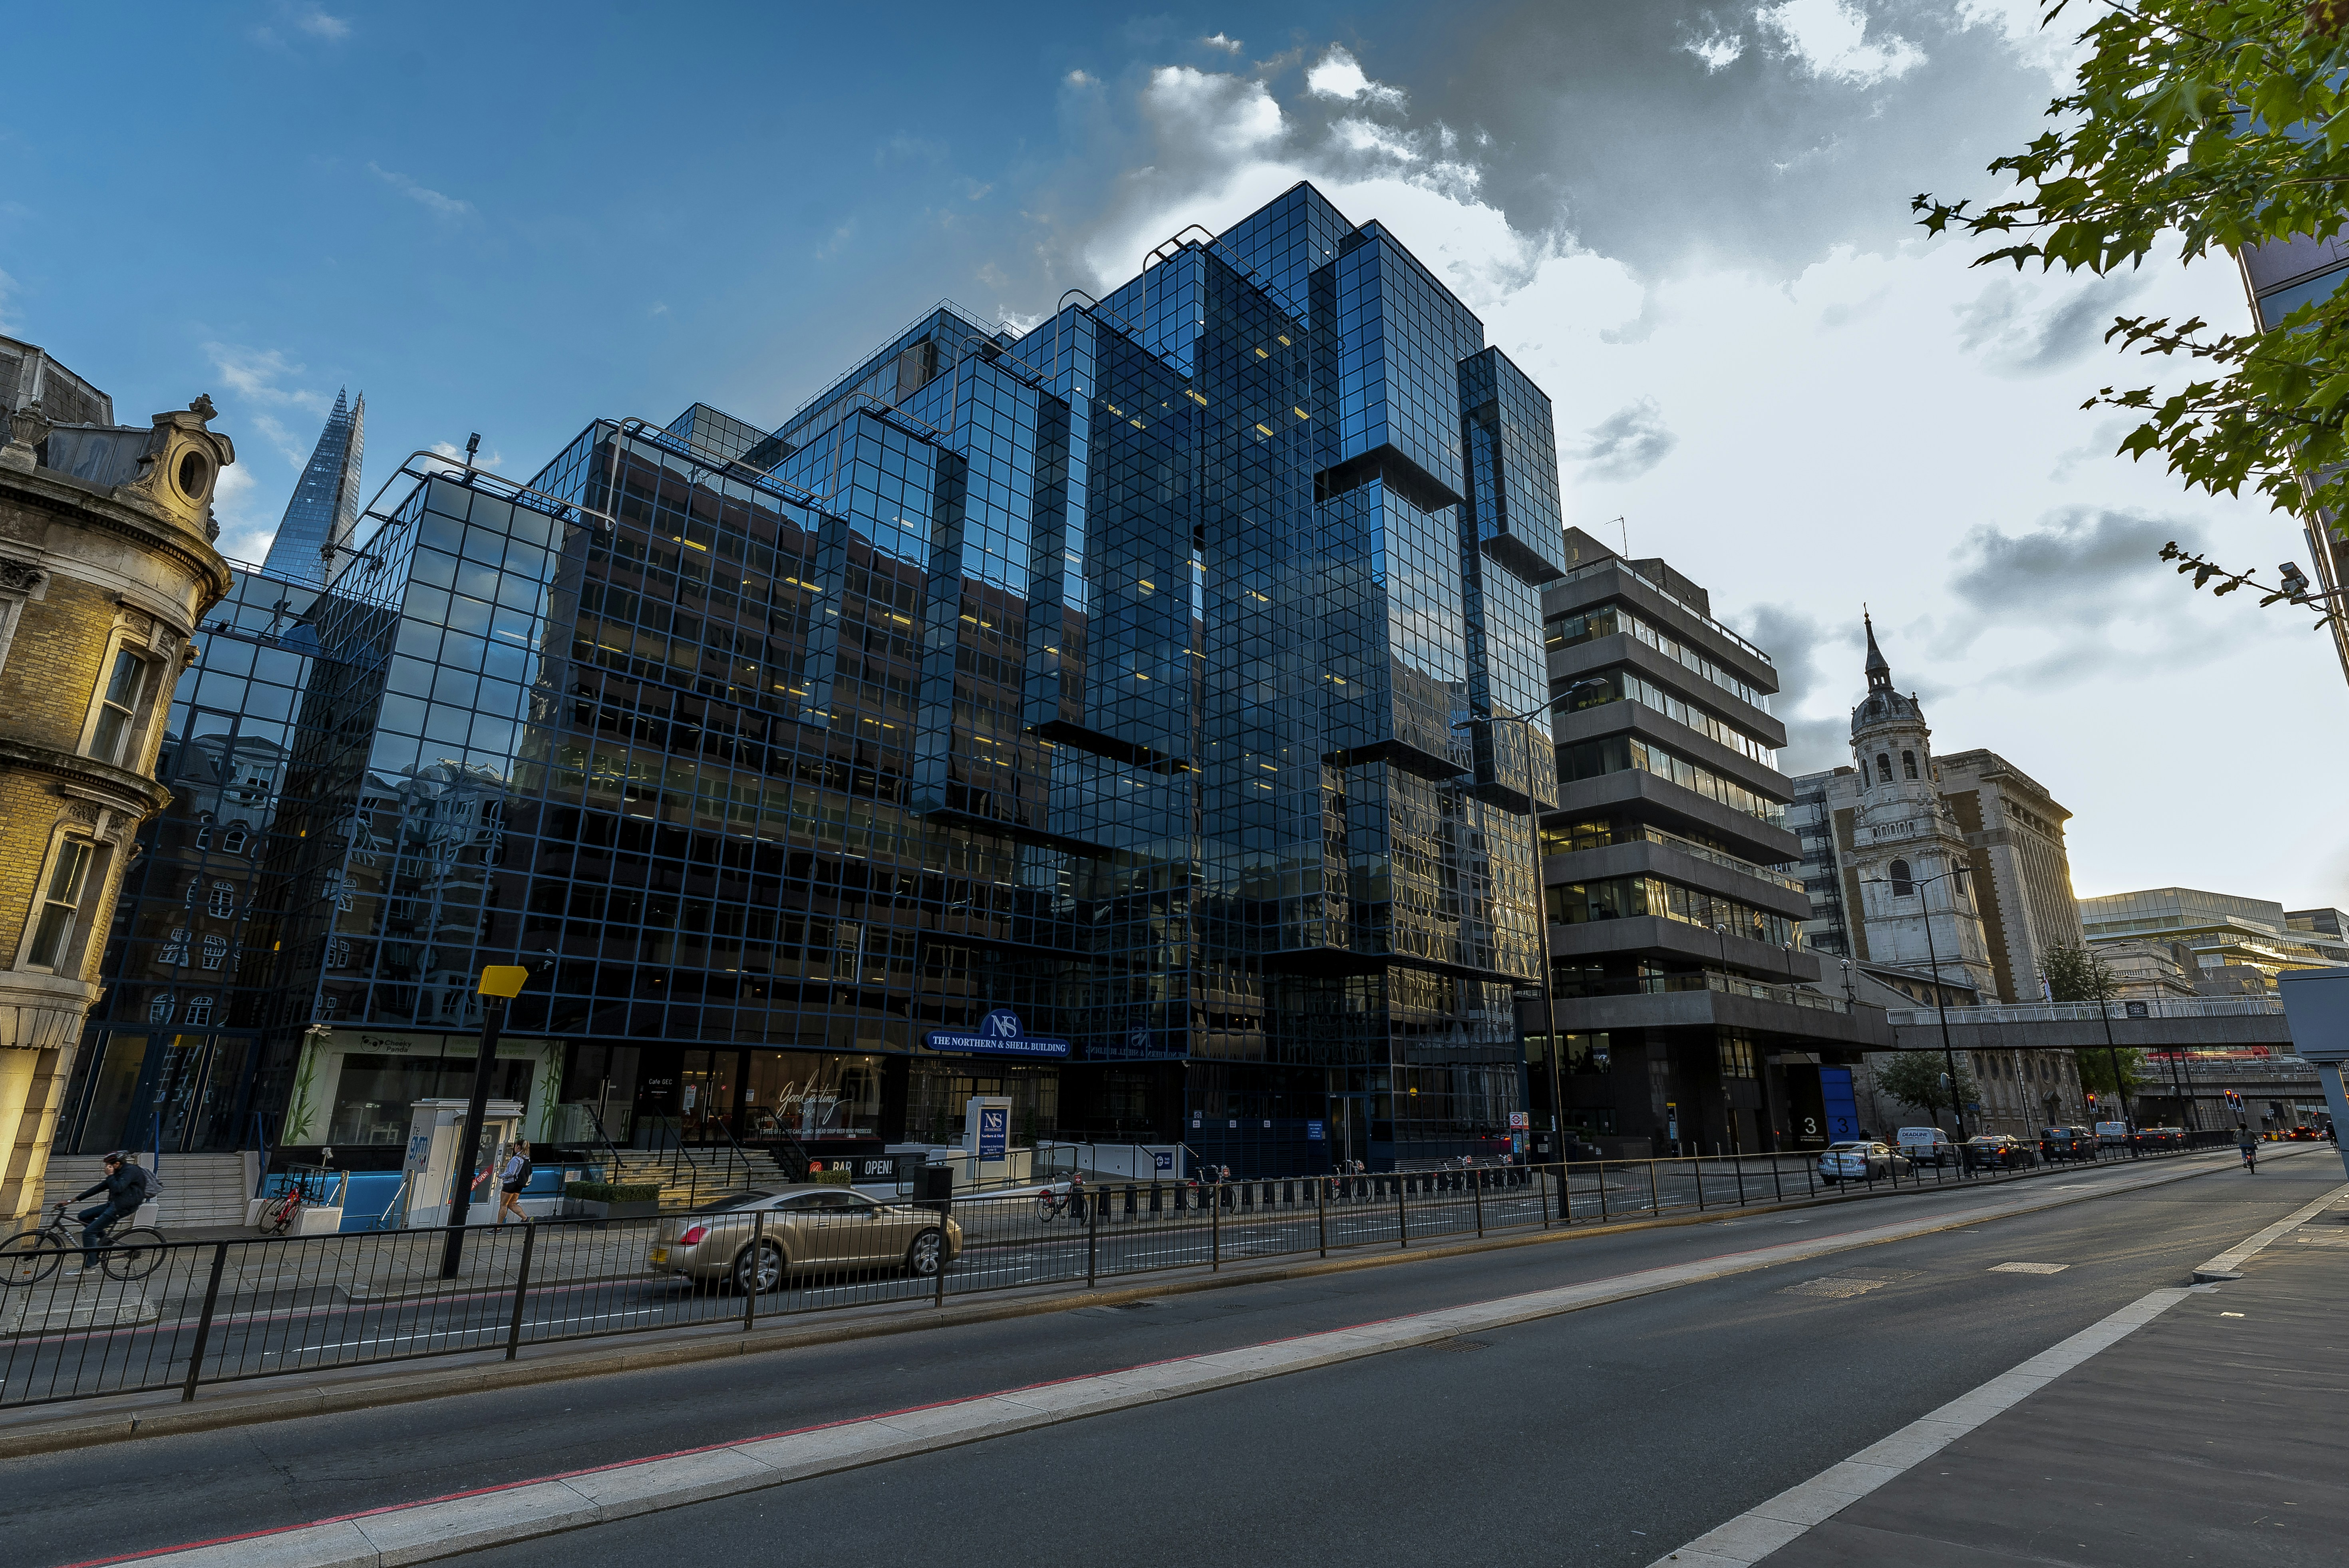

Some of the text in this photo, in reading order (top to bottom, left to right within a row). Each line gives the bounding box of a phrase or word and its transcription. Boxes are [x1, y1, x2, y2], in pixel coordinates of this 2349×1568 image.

[933, 1036, 950, 1045] THE
[952, 1037, 996, 1048] NORTHERN
[1006, 1041, 1029, 1050] SHELL
[1031, 1043, 1065, 1052] BUILDING
[1804, 1117, 1816, 1134] 3
[1838, 1118, 1849, 1133] 3
[409, 1136, 428, 1160] gym
[865, 1160, 892, 1175] OPEN!
[477, 1171, 489, 1182] OPEN!
